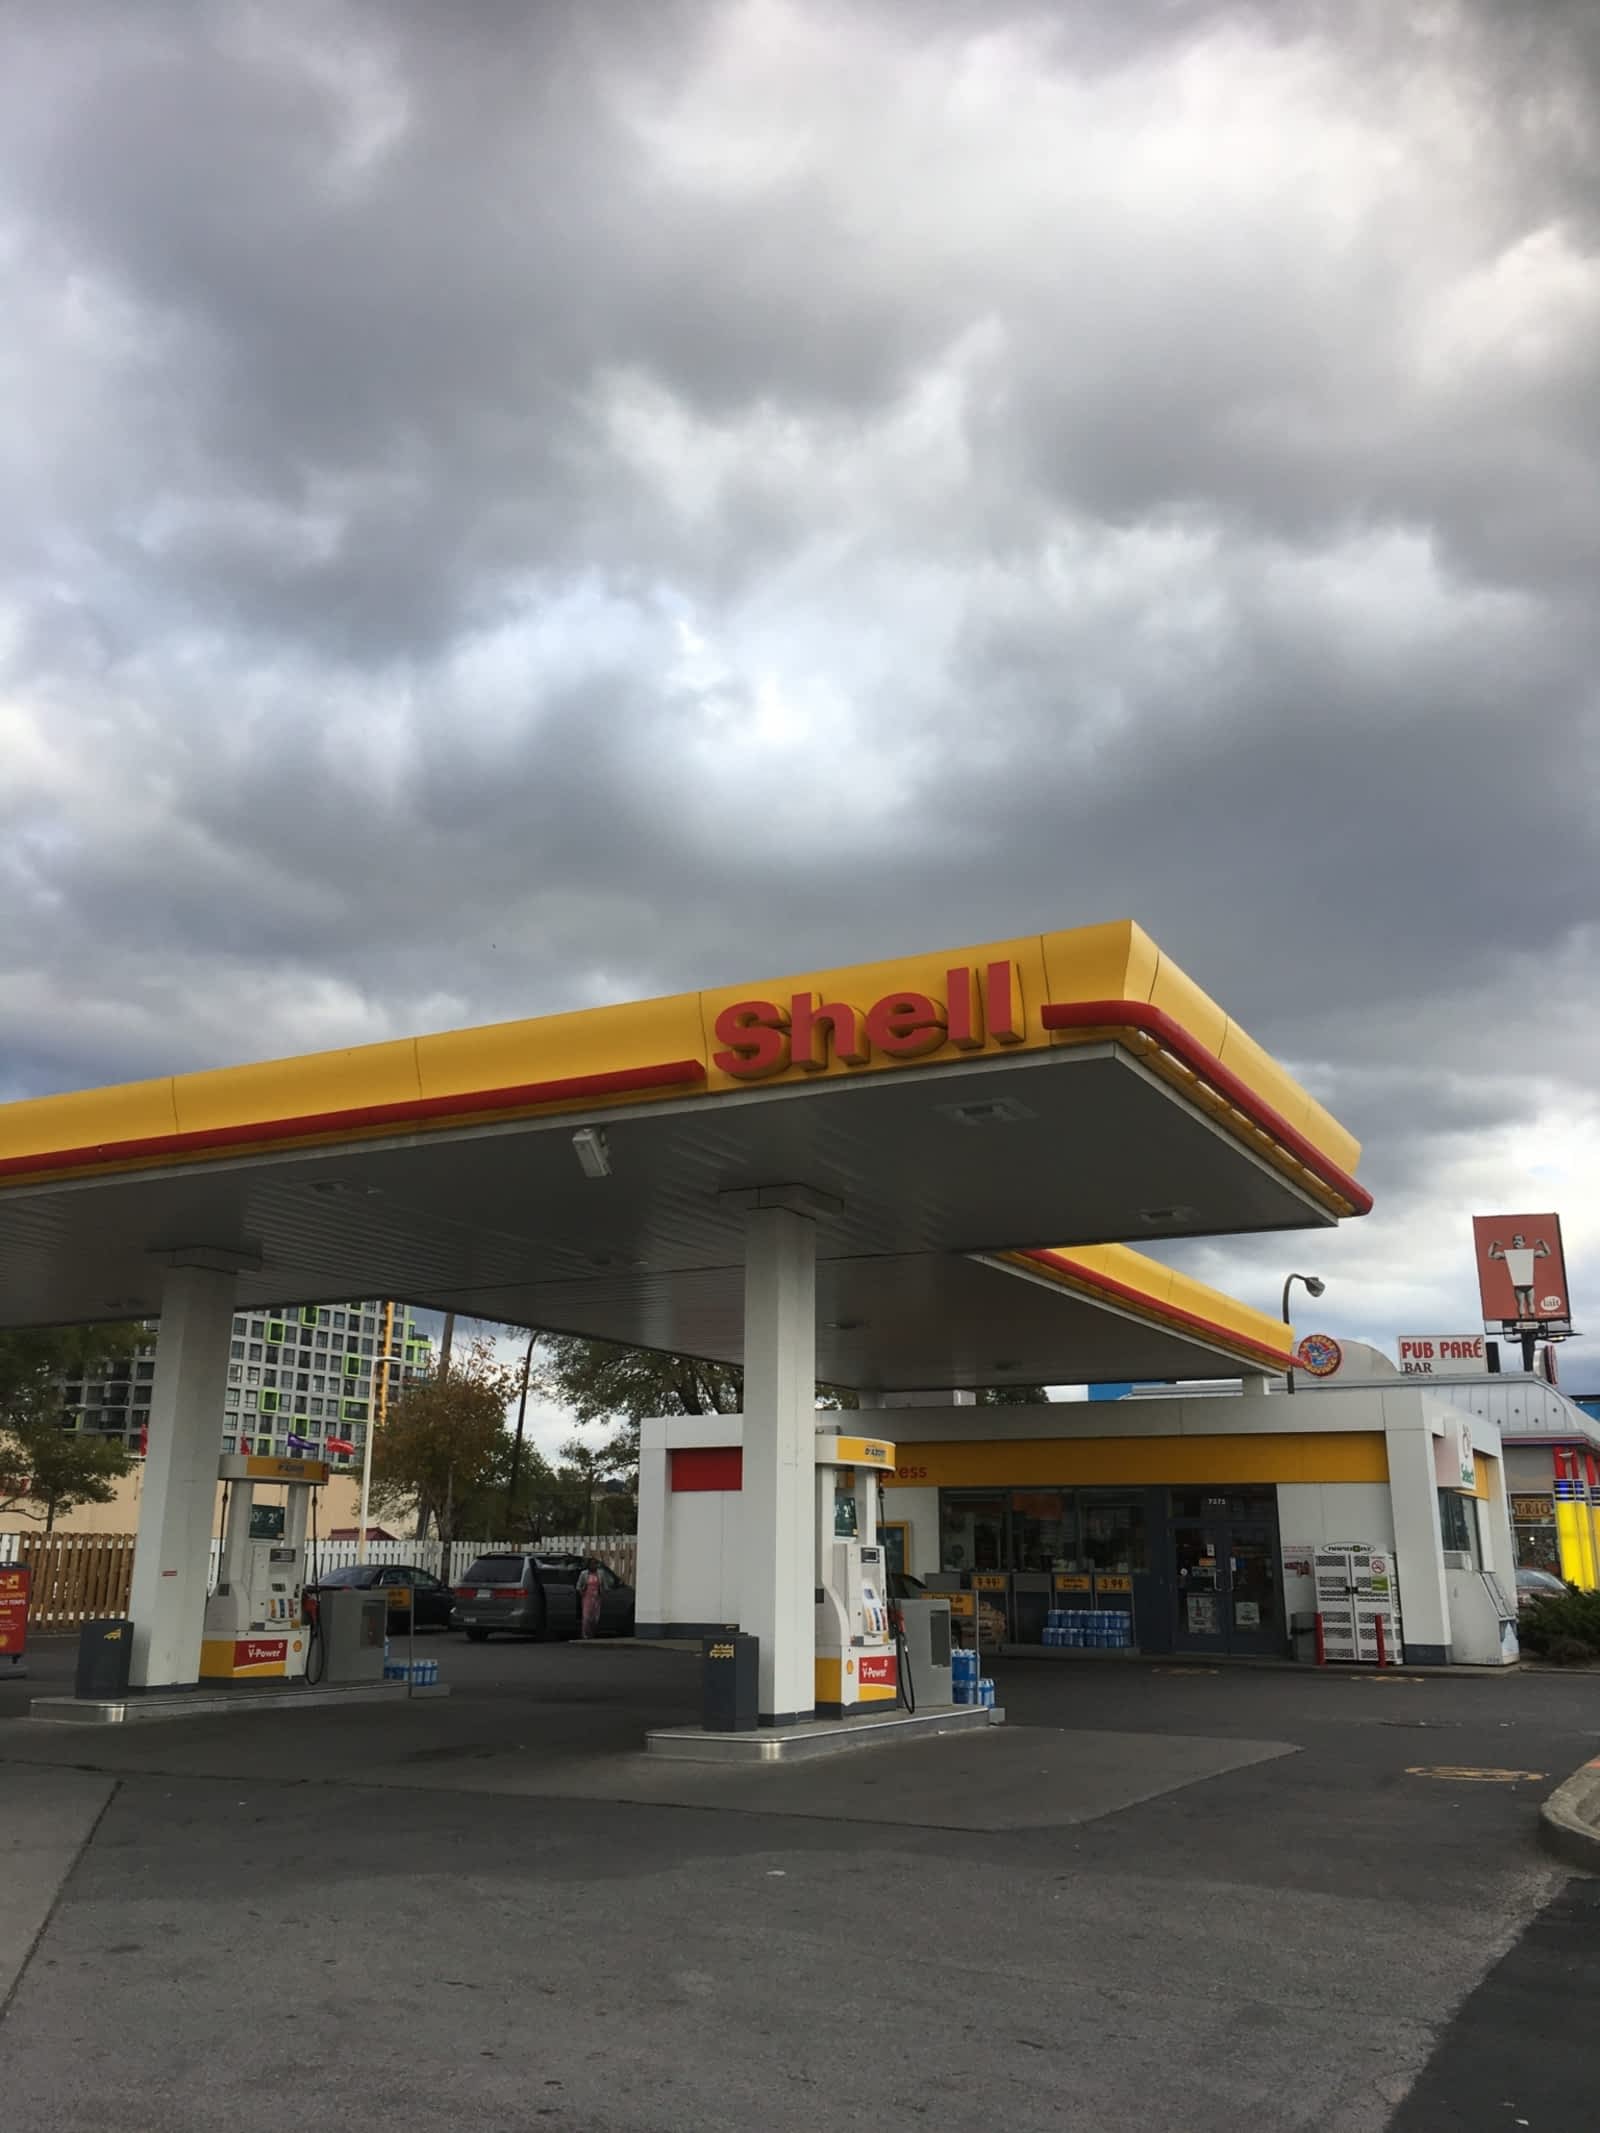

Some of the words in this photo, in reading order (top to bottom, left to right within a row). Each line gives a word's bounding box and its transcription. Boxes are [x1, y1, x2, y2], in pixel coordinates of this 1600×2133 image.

[1401, 1342, 1434, 1359] PUB
[1440, 1338, 1483, 1358] PARÉ
[1404, 1362, 1432, 1373] BAR
[248, 1648, 280, 1658] V-Power
